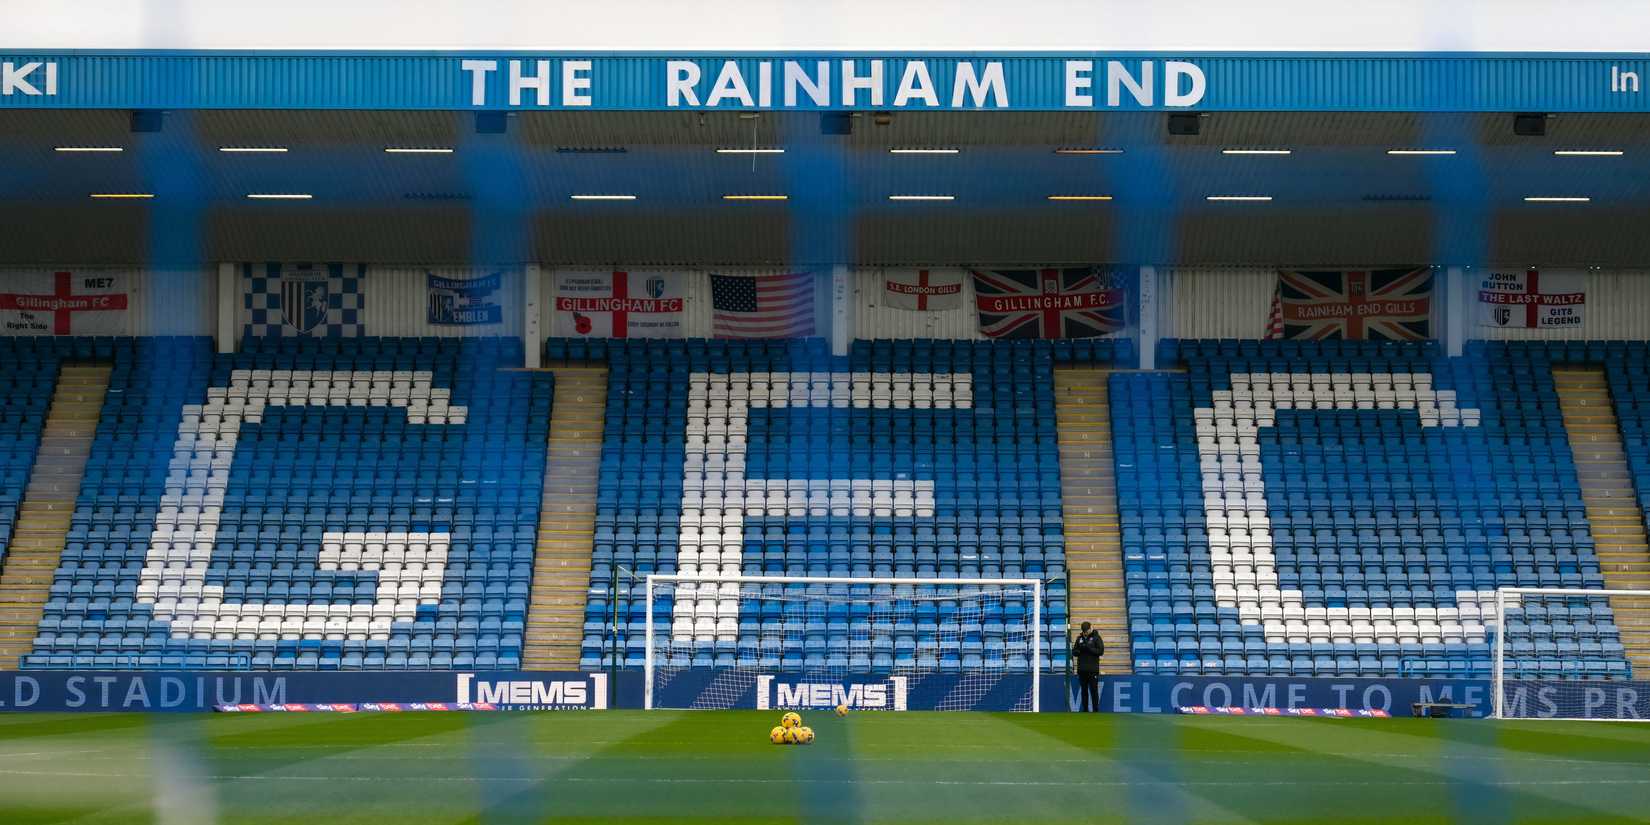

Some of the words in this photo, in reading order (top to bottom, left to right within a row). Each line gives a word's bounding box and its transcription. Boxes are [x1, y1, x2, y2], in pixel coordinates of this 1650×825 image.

[2, 61, 57, 95] KI
[461, 59, 593, 106] THE
[666, 59, 1009, 108] RAINHAM
[1065, 60, 1207, 107] END
[84, 278, 114, 289] ME7
[1488, 273, 1516, 281] JOHN
[903, 286, 936, 294] LONDON
[937, 284, 958, 293] GILLS
[1481, 280, 1523, 291] BUTTON
[15, 296, 88, 310] Gillingham
[92, 296, 110, 306] FC
[561, 298, 655, 312] GILLINGHAM
[660, 299, 678, 311] FC
[994, 295, 1083, 311] GILLINGHAM
[1482, 293, 1505, 303] THE
[1508, 294, 1539, 304] LAST
[1543, 294, 1583, 304] WALTZ
[19, 312, 35, 320] The
[1297, 304, 1353, 318] RAINHAM
[1357, 302, 1382, 315] END
[1385, 302, 1416, 313] GILLS
[6, 321, 28, 330] Right
[30, 321, 48, 330] Side
[1541, 316, 1581, 325] LEGEND
[0, 676, 40, 708] D
[65, 676, 287, 708] STADIUM
[477, 681, 587, 704] MEMS
[777, 683, 888, 707] MEMS
[1331, 684, 1392, 712] TO
